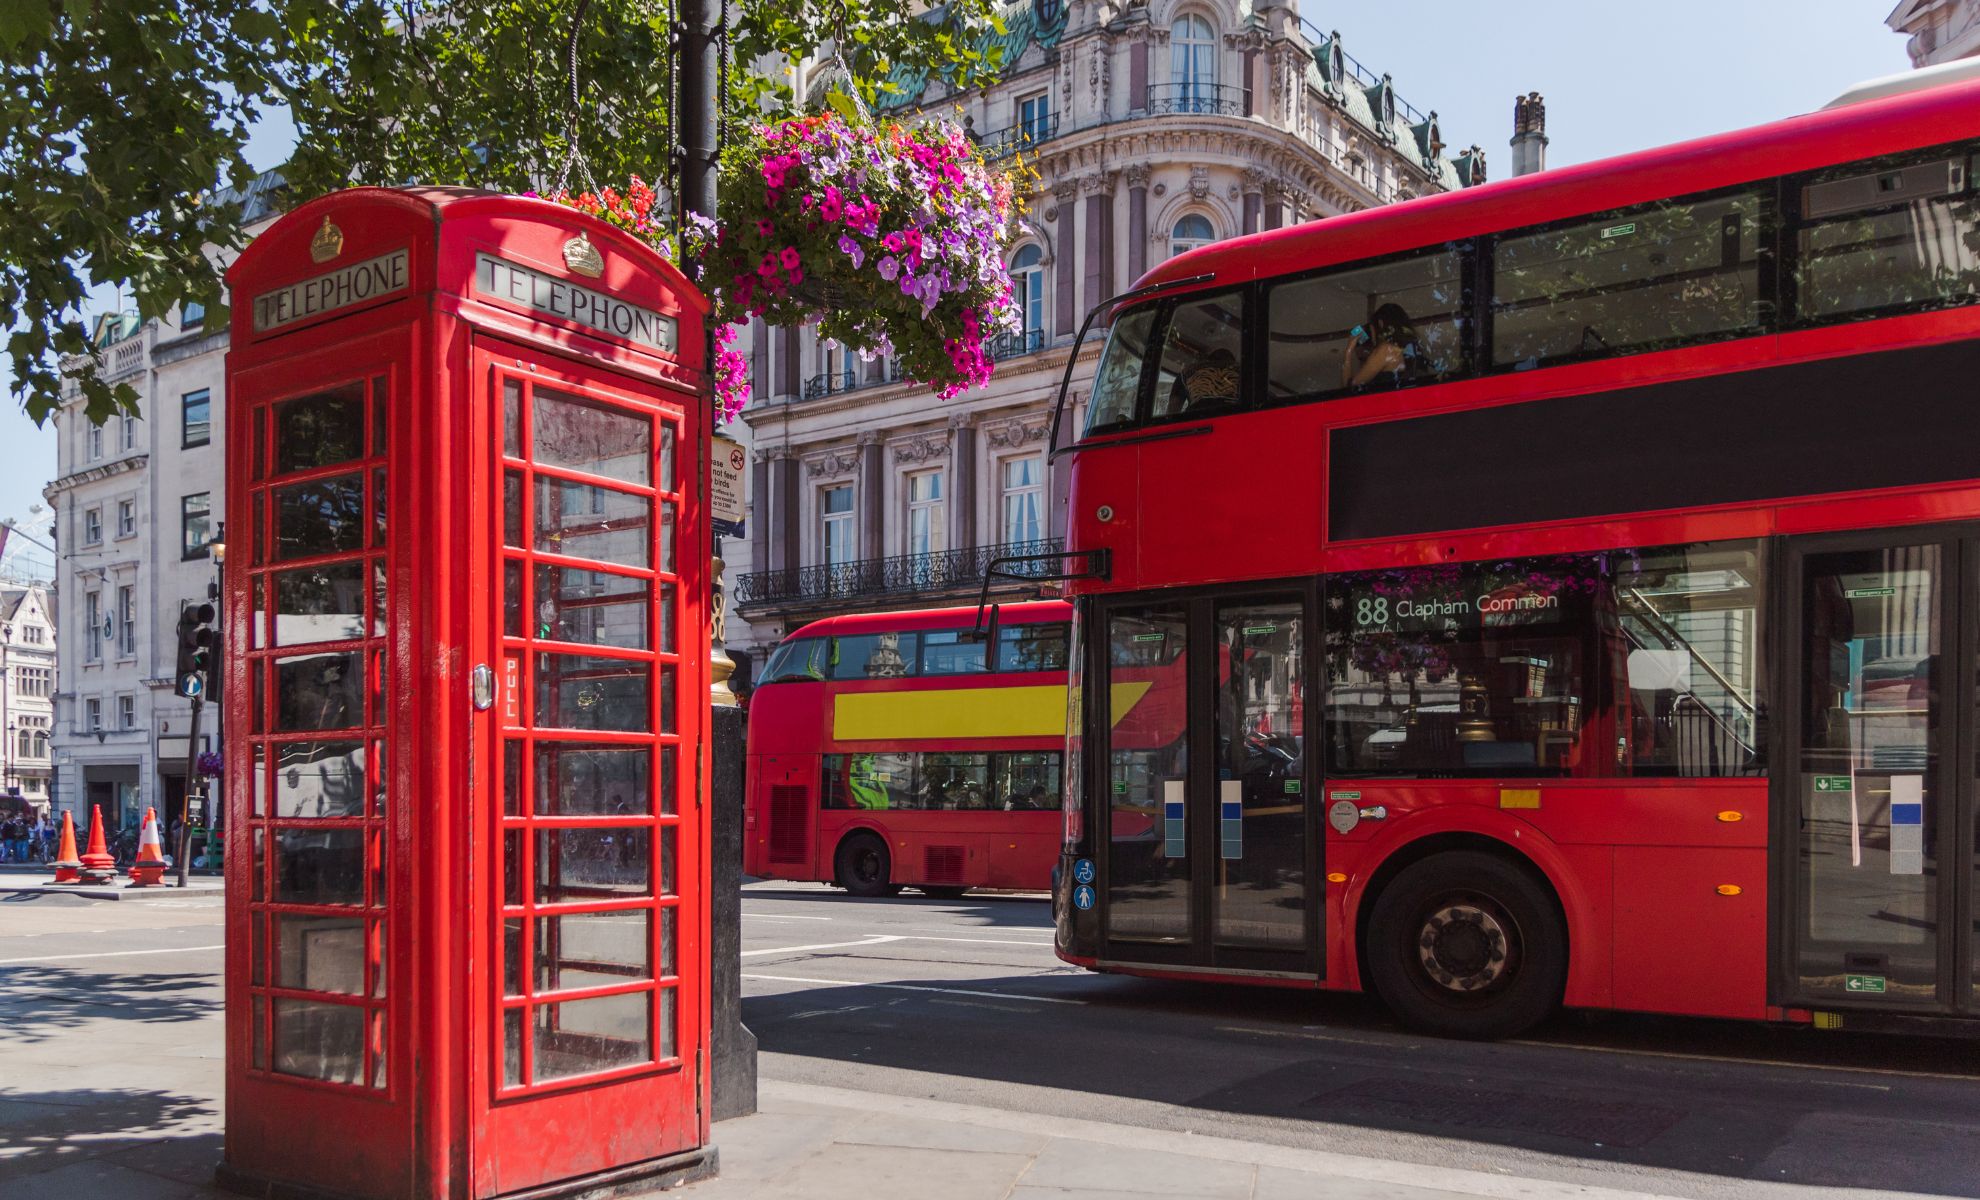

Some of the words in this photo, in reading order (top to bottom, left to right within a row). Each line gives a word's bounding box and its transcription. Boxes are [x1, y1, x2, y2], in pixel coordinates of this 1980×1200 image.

[257, 254, 406, 327] TELEPHONE
[482, 258, 673, 350] TELEPHONE
[712, 459, 724, 468] ase
[713, 469, 723, 477] not
[724, 471, 737, 481] feed
[714, 478, 730, 488] birds
[1356, 597, 1389, 625] 88
[1396, 599, 1469, 621] Clapham
[1476, 594, 1558, 612] Common
[507, 660, 516, 717] PULL
